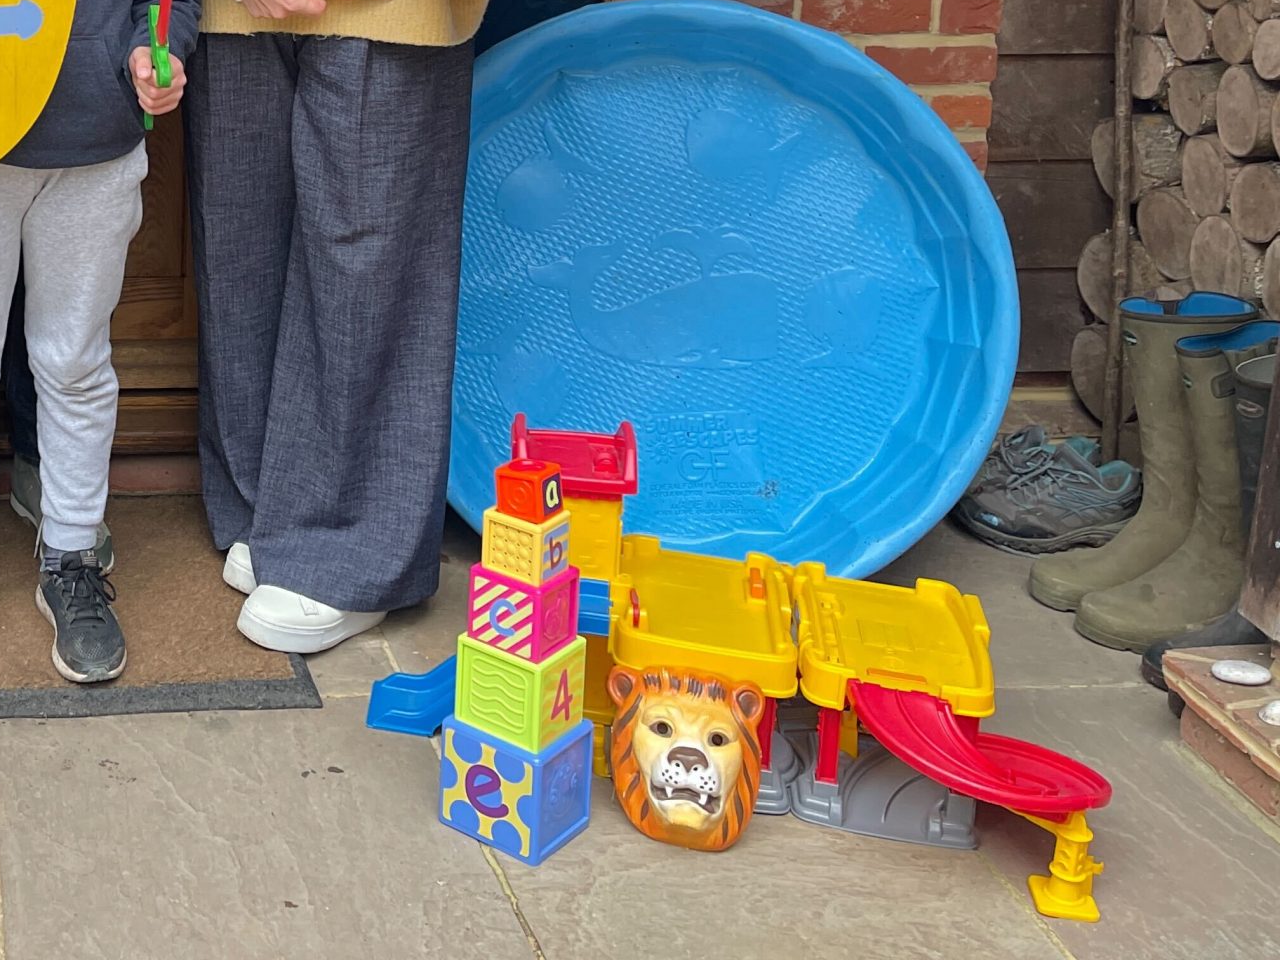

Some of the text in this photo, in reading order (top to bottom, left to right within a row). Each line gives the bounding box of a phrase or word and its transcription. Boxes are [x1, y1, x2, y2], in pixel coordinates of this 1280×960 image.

[643, 413, 728, 434] SUMMER
[671, 428, 759, 448] ESCAPES
[678, 448, 729, 481] GF
[545, 480, 560, 508] a
[549, 536, 563, 570] b
[550, 668, 573, 721] 4
[464, 763, 510, 820] e
